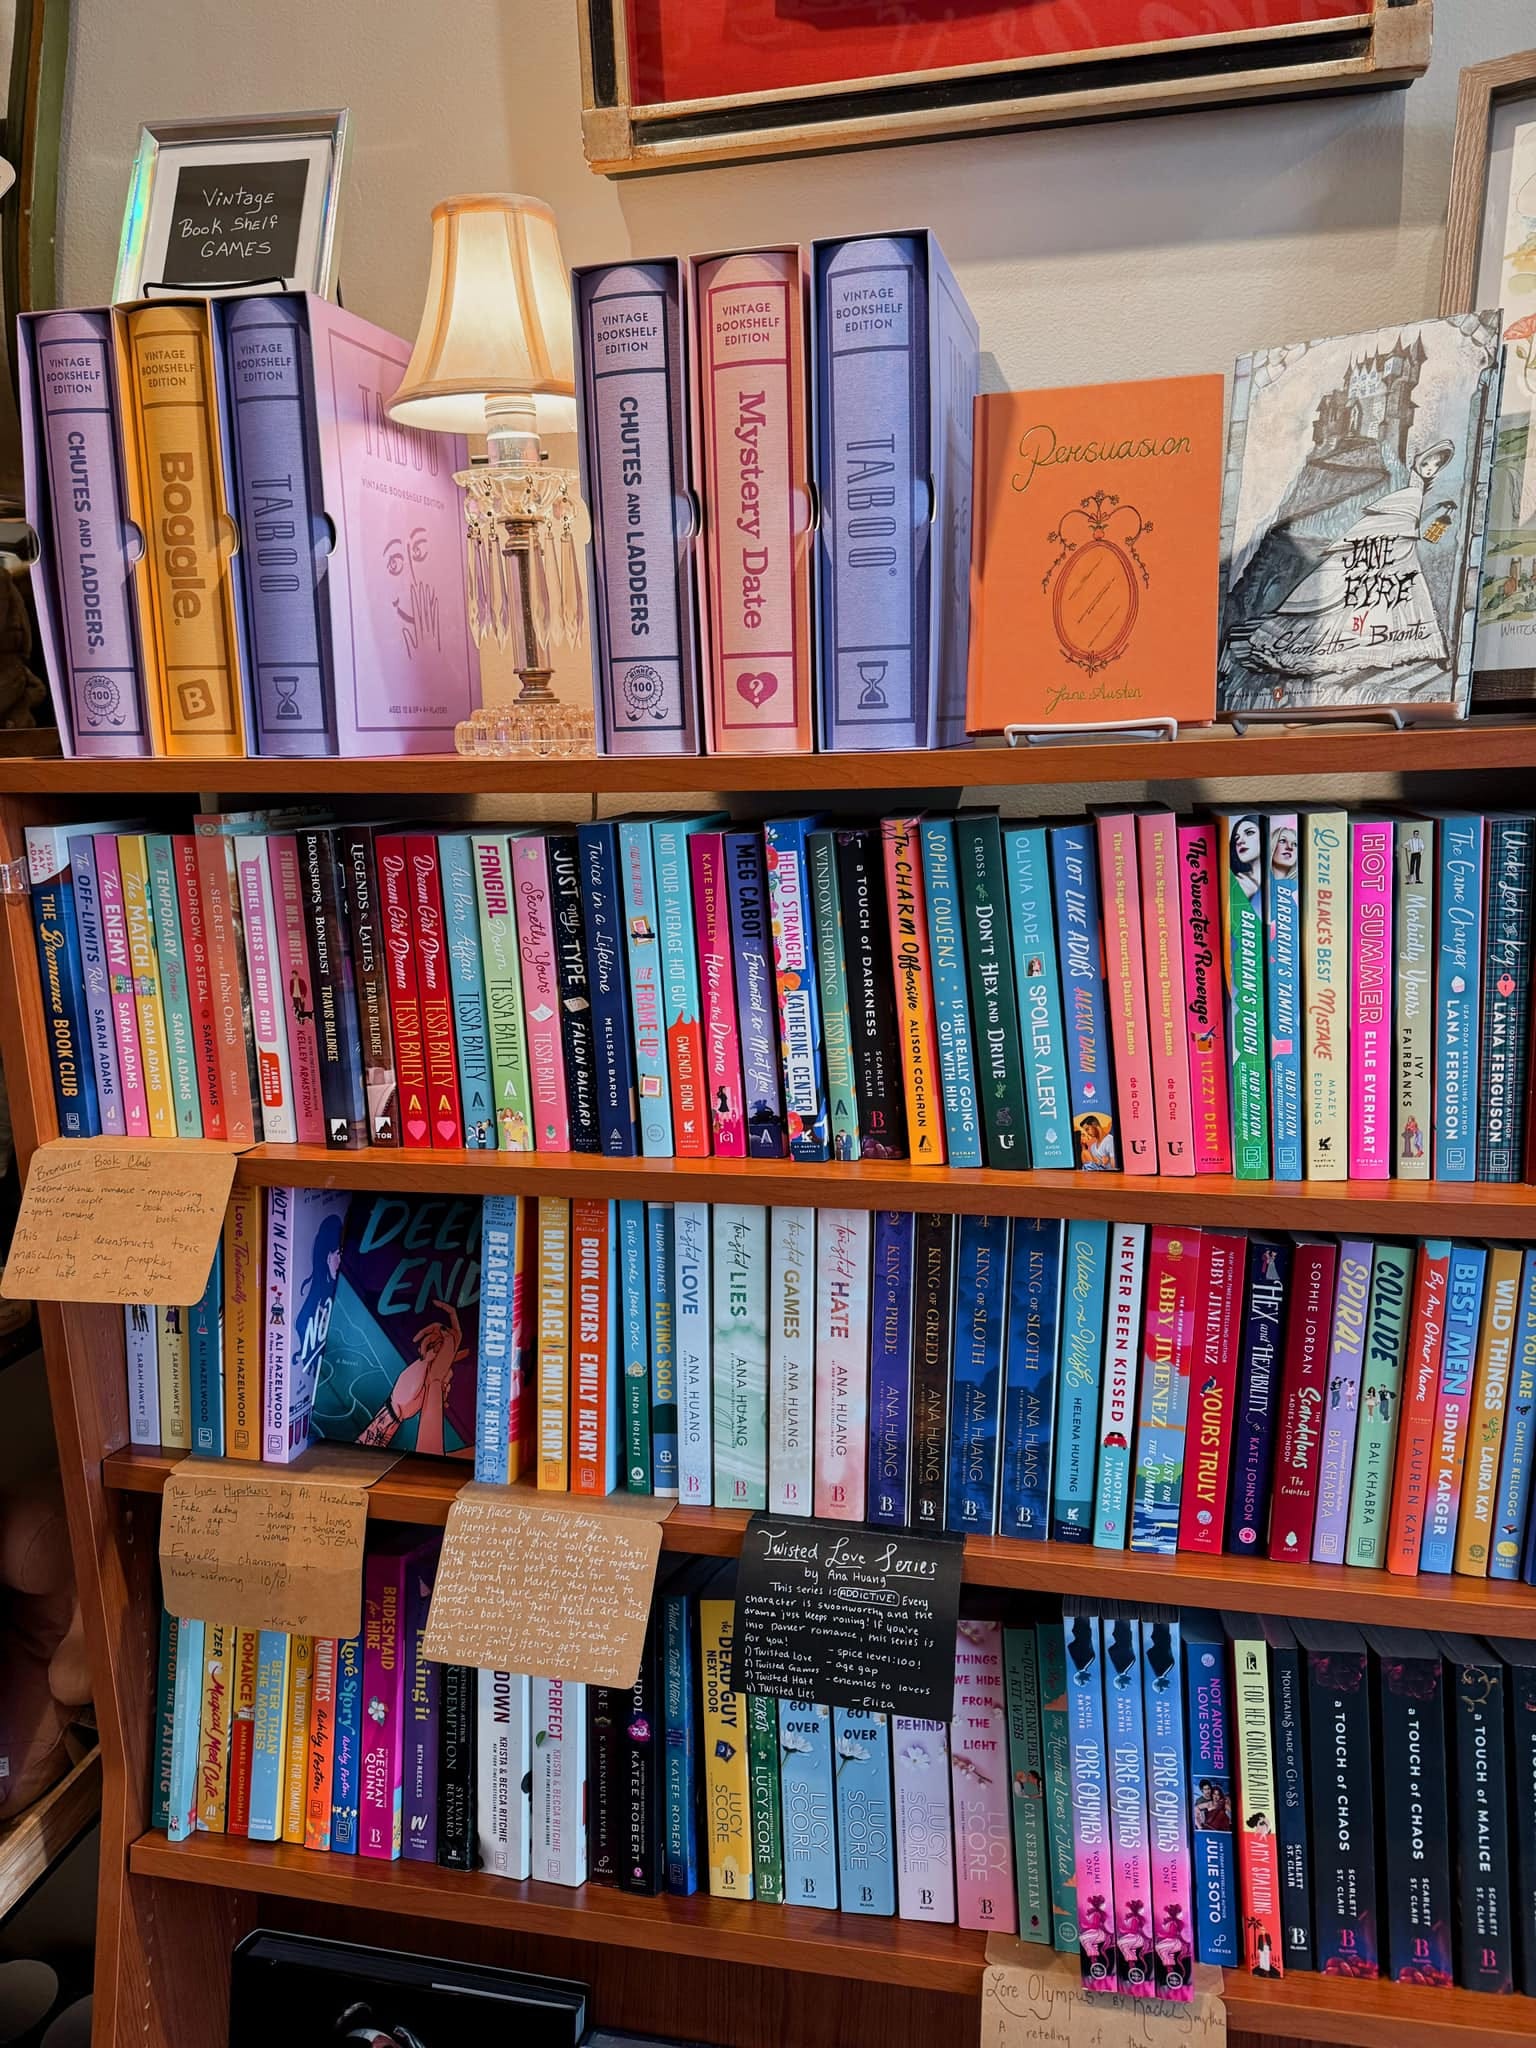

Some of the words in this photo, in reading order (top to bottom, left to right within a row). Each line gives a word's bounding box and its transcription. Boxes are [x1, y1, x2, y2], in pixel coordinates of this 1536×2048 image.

[203, 189, 275, 211] Vintage
[180, 217, 222, 237] Book
[230, 215, 277, 234] Shelf
[201, 240, 272, 257] GAMES
[722, 302, 771, 315] VINTAGE
[836, 302, 903, 318] BOOKSHELF
[843, 287, 894, 302] VINTAGE
[597, 326, 658, 342] BOOKSHELF
[602, 311, 648, 325] VINTAGE
[717, 316, 780, 333] BOOKSHELF
[725, 332, 770, 346] EDITION
[845, 318, 892, 332] EDITION
[49, 357, 91, 368] VINTAGE
[142, 362, 196, 375] BOOKSHELF
[145, 350, 185, 362] VINTAGE
[236, 357, 292, 369] BOOKSHELF
[241, 343, 282, 355] VINTAGE
[605, 341, 648, 354] EDITION
[46, 369, 101, 382] BOOKSHELF
[53, 383, 92, 394] EDITION
[148, 375, 187, 387] EDITION
[243, 370, 283, 382] EDITION
[618, 397, 639, 486] CHUTES
[1011, 425, 1192, 492] Persuasion
[67, 432, 90, 512] CHUTES
[735, 391, 766, 540] Mystery
[627, 494, 640, 525] AND
[846, 433, 896, 568] TABOO
[77, 519, 91, 547] AND
[160, 452, 201, 621] Boggle
[250, 474, 300, 593] TABOO
[1344, 535, 1399, 571] JANE
[81, 553, 104, 651] LADDERS
[627, 531, 649, 636] LADDERS
[743, 547, 768, 629] Date
[1344, 571, 1417, 610] EYRE
[1271, 631, 1360, 656] Charlotte
[1368, 620, 1432, 646] Brontë
[1352, 612, 1368, 634] BY
[632, 682, 652, 692] 100
[1044, 686, 1086, 714] Jane
[1093, 685, 1142, 701] Austen
[479, 845, 508, 919] FANGIRL
[553, 850, 577, 898] JUST
[703, 854, 712, 882] KATE
[735, 844, 756, 882] MEG
[778, 853, 796, 895] HELLO
[1016, 837, 1032, 896] OLIVIA
[1361, 834, 1385, 892] HOT
[41, 894, 56, 921] THE
[78, 875, 100, 970] OFF-LIMITS
[307, 836, 321, 902] BOOKSHOPS
[315, 916, 328, 975] BONEDUST
[704, 886, 717, 943] BROMLEY
[738, 887, 761, 939] CABOT
[857, 876, 869, 929] TOUCH
[1022, 901, 1039, 945] DADE
[105, 904, 126, 966] ENEMY
[129, 904, 149, 968] MATCH
[781, 901, 802, 968] STRANGER
[861, 936, 869, 951] of
[976, 904, 994, 955] DON'T
[40, 923, 65, 1013] Bromance
[562, 942, 586, 985] TYPE
[981, 963, 998, 996] HEX
[1241, 910, 1256, 1005] BARBARIAN'S
[1359, 904, 1384, 1024] SUMMER
[321, 985, 335, 1020] TRAVIS
[395, 998, 418, 1039] TESSA
[490, 977, 512, 1019] TESSA
[862, 958, 876, 1037] DARKNESS
[988, 1001, 997, 1023] AND
[53, 1019, 74, 1055] BOOK
[95, 1008, 108, 1049] SARAH
[118, 1002, 132, 1042] SARAH
[325, 1022, 338, 1062] BALDREE
[571, 1022, 586, 1064] FALON
[605, 1018, 614, 1063] MELISSA
[788, 994, 807, 1060] KATHERINE
[910, 1019, 921, 1064] ALISON
[1029, 985, 1051, 1058] SPOILER
[1242, 1008, 1258, 1056] TOUCH
[1446, 1000, 1460, 1045] LANA
[124, 1046, 137, 1089] ADAMS
[401, 1043, 424, 1088] BAILEY
[497, 1022, 519, 1071] BAILEY
[676, 1036, 692, 1080] GWENDA
[987, 1028, 1005, 1079] DRIVE
[1364, 1031, 1377, 1068] ELLE
[60, 1057, 77, 1097] CLUB
[100, 1052, 113, 1094] ADAMS
[608, 1069, 616, 1107] BARON
[792, 1065, 813, 1113] CENTER
[1034, 1064, 1058, 1119] ALERT
[577, 1069, 591, 1127] BALLARD
[680, 1084, 694, 1112] BOND
[914, 1067, 927, 1127] COCHRUN
[1362, 1073, 1376, 1154] EVERHART
[1445, 1051, 1459, 1140] FERGUSON
[273, 1242, 287, 1283] LOVE
[487, 1231, 509, 1301] BEACH
[581, 1237, 599, 1280] BOOK
[1119, 1236, 1135, 1296] NEVER
[682, 1264, 698, 1315] LOVE
[730, 1271, 747, 1317] LIES
[783, 1269, 800, 1339] GAMES
[830, 1281, 849, 1338] HATE
[1160, 1272, 1177, 1331] ABBY
[1334, 1259, 1369, 1356] SPIRAL
[1451, 1263, 1477, 1329] BEST
[1492, 1279, 1515, 1330] WILD
[485, 1304, 507, 1357] READ
[580, 1282, 600, 1343] LOVERS
[655, 1302, 671, 1355] FLYING
[1116, 1305, 1132, 1351] BEEN
[1371, 1260, 1404, 1368] COLLIDE
[579, 1354, 598, 1404] EMILY
[656, 1360, 672, 1399] SOLO
[688, 1354, 699, 1390] ANA
[1152, 1333, 1172, 1429] JIMENEZ
[1443, 1332, 1473, 1396] MEN
[1484, 1336, 1509, 1411] THINGS
[273, 1352, 282, 1429] HAZELWOOD
[486, 1366, 501, 1409] EMILY
[1111, 1358, 1126, 1422] KISSED
[484, 1410, 499, 1451] HENRY
[578, 1407, 598, 1463] HENRY
[688, 1391, 700, 1442] HUANG
[1202, 1388, 1224, 1447] YOURS
[1441, 1403, 1459, 1464] SIDNEY
[1196, 1450, 1220, 1503] TRULY
[1432, 1465, 1453, 1536] KARGER
[757, 1530, 818, 1560] Twisted
[825, 1537, 866, 1567] Love
[804, 1567, 818, 1584] by
[828, 1571, 848, 1581] Ana
[853, 1572, 886, 1587] Huang
[902, 1596, 929, 1610] Every
[381, 1586, 396, 1671] BRIDESMAID
[706, 1650, 717, 1678] NEXT
[955, 1654, 998, 1666] THINGS
[708, 1681, 718, 1713] DOOR
[863, 1697, 896, 1708] Eliza
[962, 1696, 993, 1707] FROM
[1197, 1686, 1208, 1722] LOVE
[1210, 1678, 1222, 1703] NOT
[786, 1722, 819, 1734] OVER
[963, 1740, 996, 1751] LIGHT
[968, 1718, 990, 1729] THE
[1199, 1725, 1211, 1760] SONG
[1212, 1708, 1225, 1769] ANOTHER
[1334, 1713, 1346, 1768] TOUCH
[1474, 1726, 1488, 1783] TOUCH
[365, 1753, 376, 1801] QUINN
[374, 1747, 384, 1809] MEGHAN
[1337, 1776, 1345, 1789] of
[1477, 1789, 1484, 1803] of
[1337, 1795, 1350, 1851] CHAOS
[1476, 1809, 1491, 1872] MALICE
[1206, 1838, 1220, 1874] JULIE
[1207, 1879, 1220, 1923] SOTO
